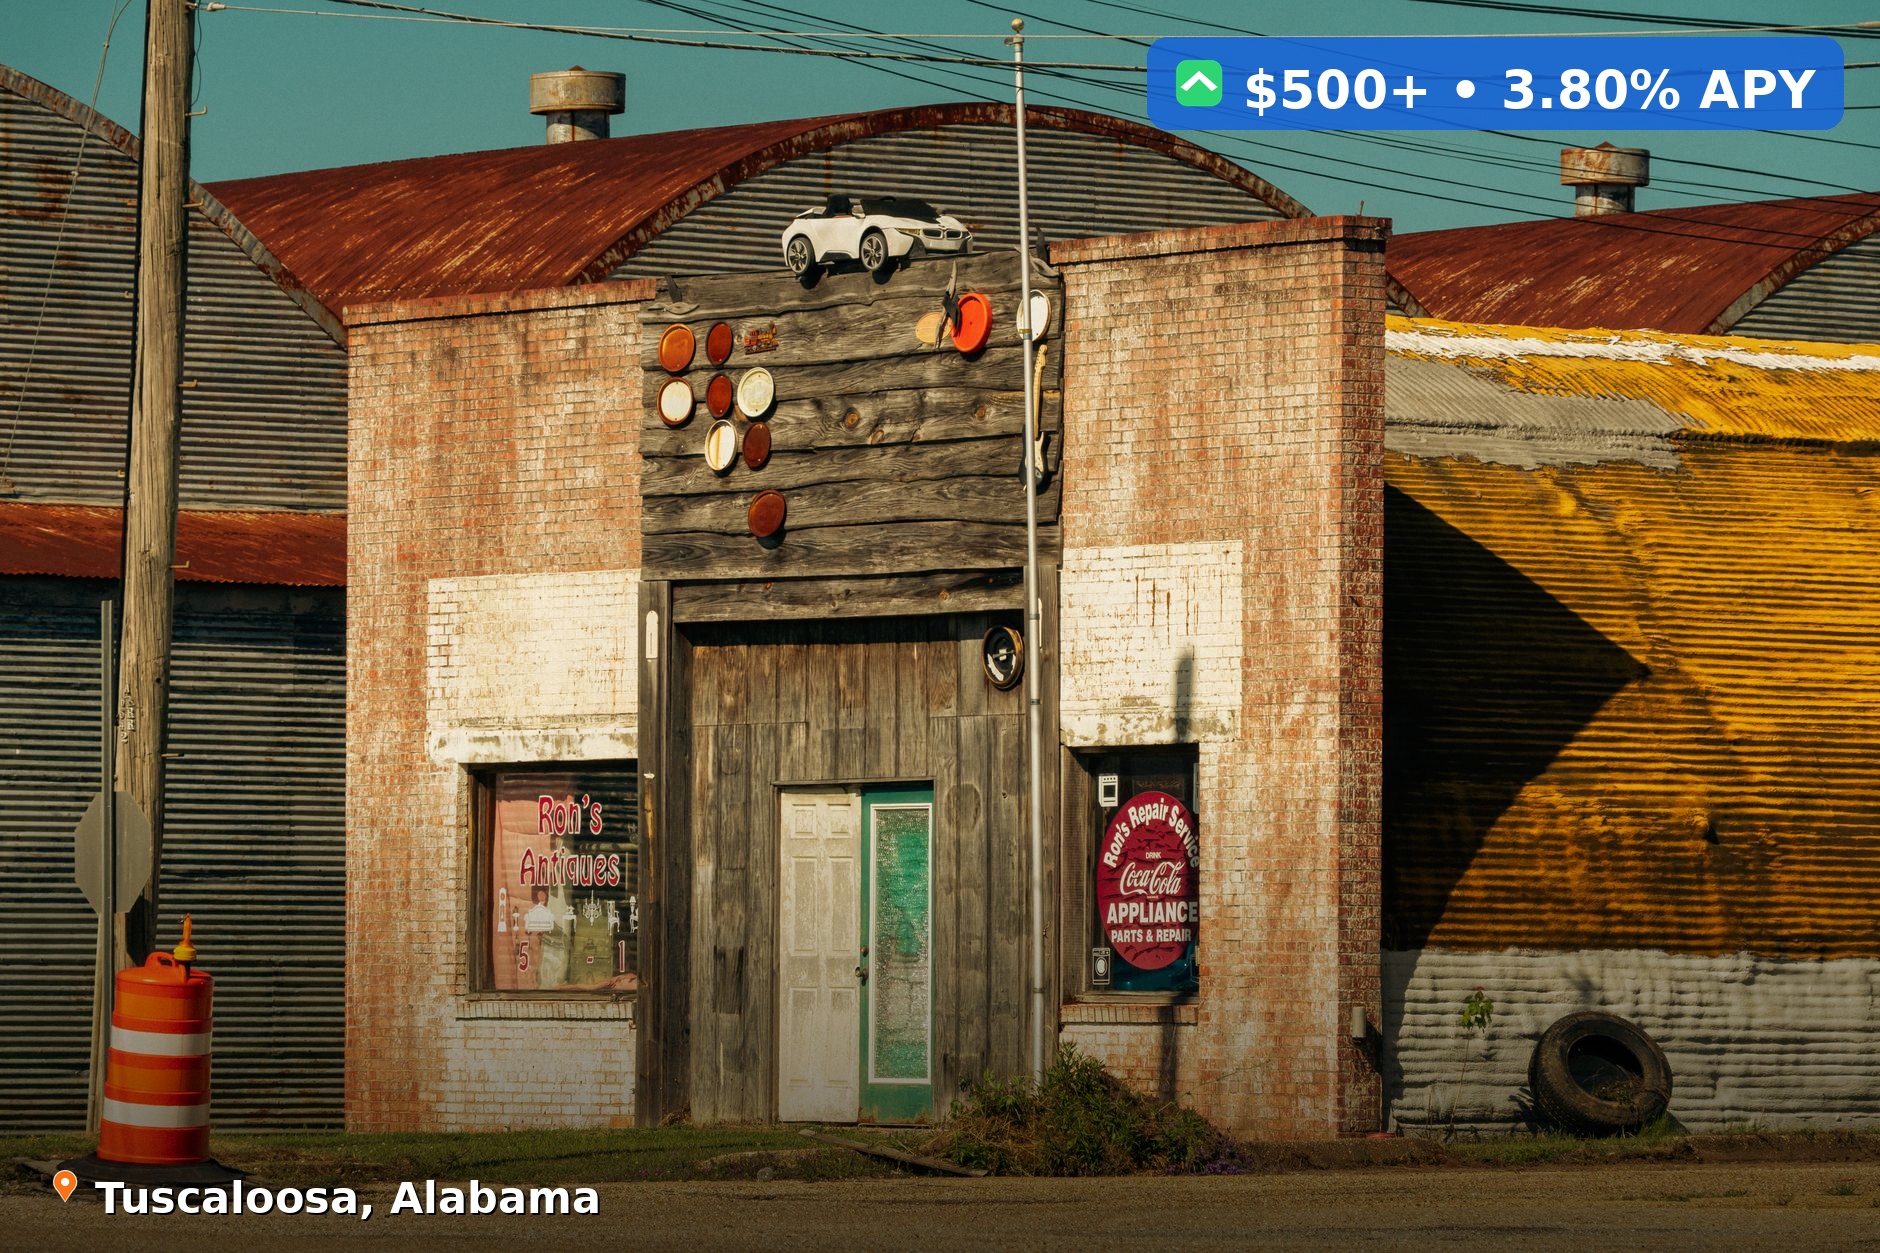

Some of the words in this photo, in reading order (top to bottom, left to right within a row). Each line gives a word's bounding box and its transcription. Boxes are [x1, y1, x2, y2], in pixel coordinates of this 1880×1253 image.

[538, 794, 603, 836] Ron's
[1103, 822, 1130, 868] Ron's
[1128, 797, 1169, 829] Repair
[1168, 805, 1200, 868] Service
[520, 847, 620, 886] Antiques
[1106, 901, 1199, 924] APPLIANCE
[1111, 929, 1143, 943] PARTS
[1145, 929, 1154, 943] &
[1156, 928, 1192, 943] REPAIR
